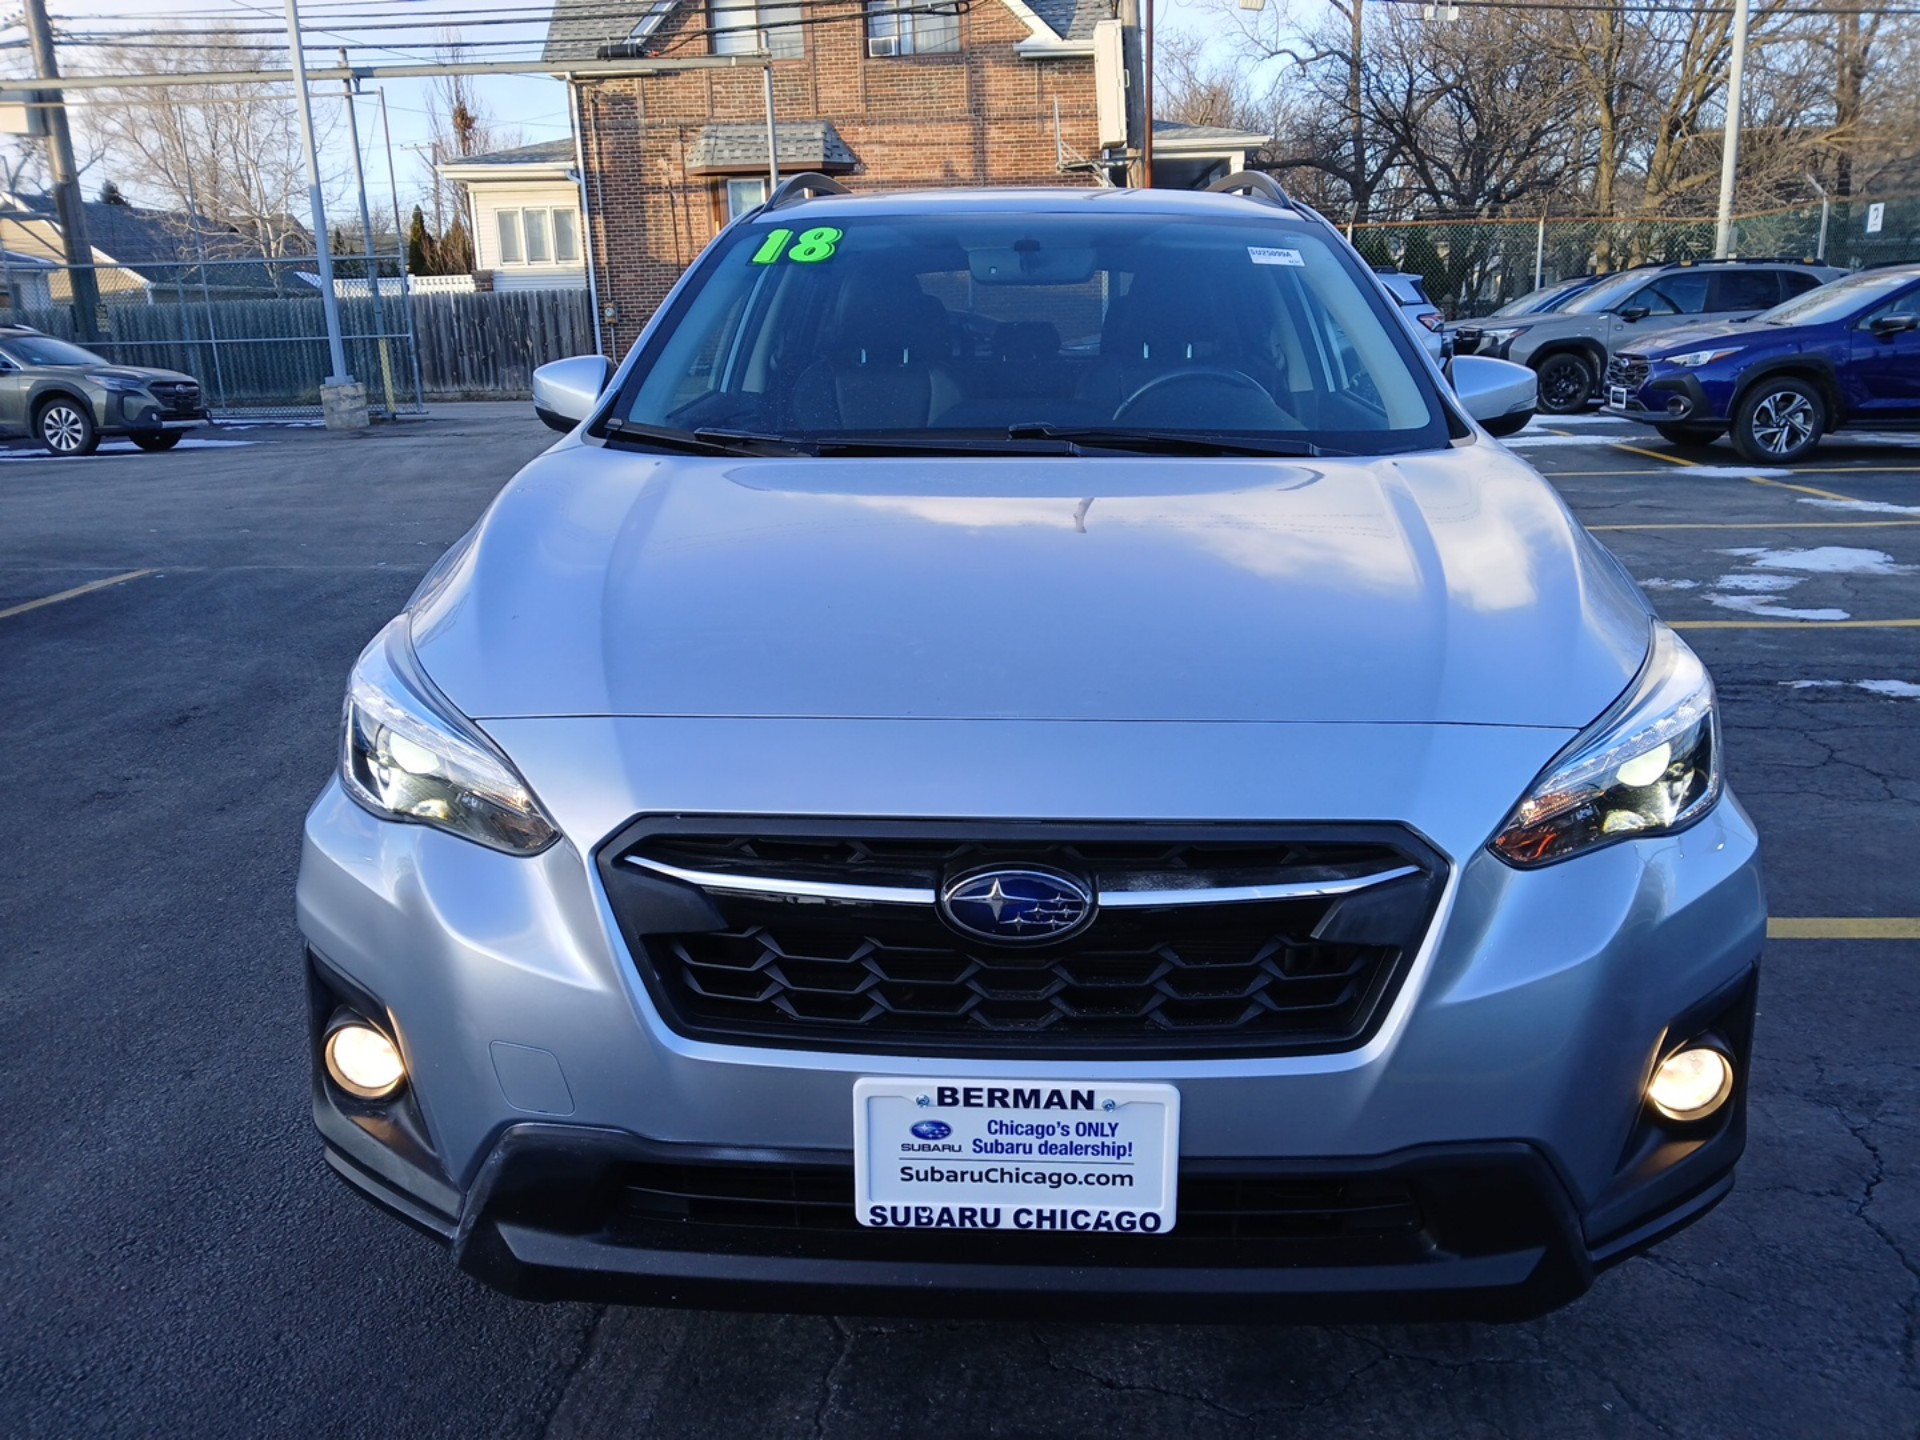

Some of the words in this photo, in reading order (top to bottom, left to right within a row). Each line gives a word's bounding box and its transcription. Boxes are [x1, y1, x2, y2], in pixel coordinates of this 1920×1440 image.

[752, 227, 843, 264] 18
[936, 1086, 1095, 1111] BERMAN
[987, 1119, 1070, 1139] Chicago's
[1075, 1122, 1119, 1137] ONLY
[901, 1143, 962, 1153] SUBARU
[972, 1138, 1033, 1155] Subaru
[1038, 1140, 1133, 1160] dealership!
[900, 1166, 1134, 1189] SubaruChicago.com
[869, 1205, 1000, 1228] SUBARU
[1013, 1208, 1161, 1232] CHICAGO
